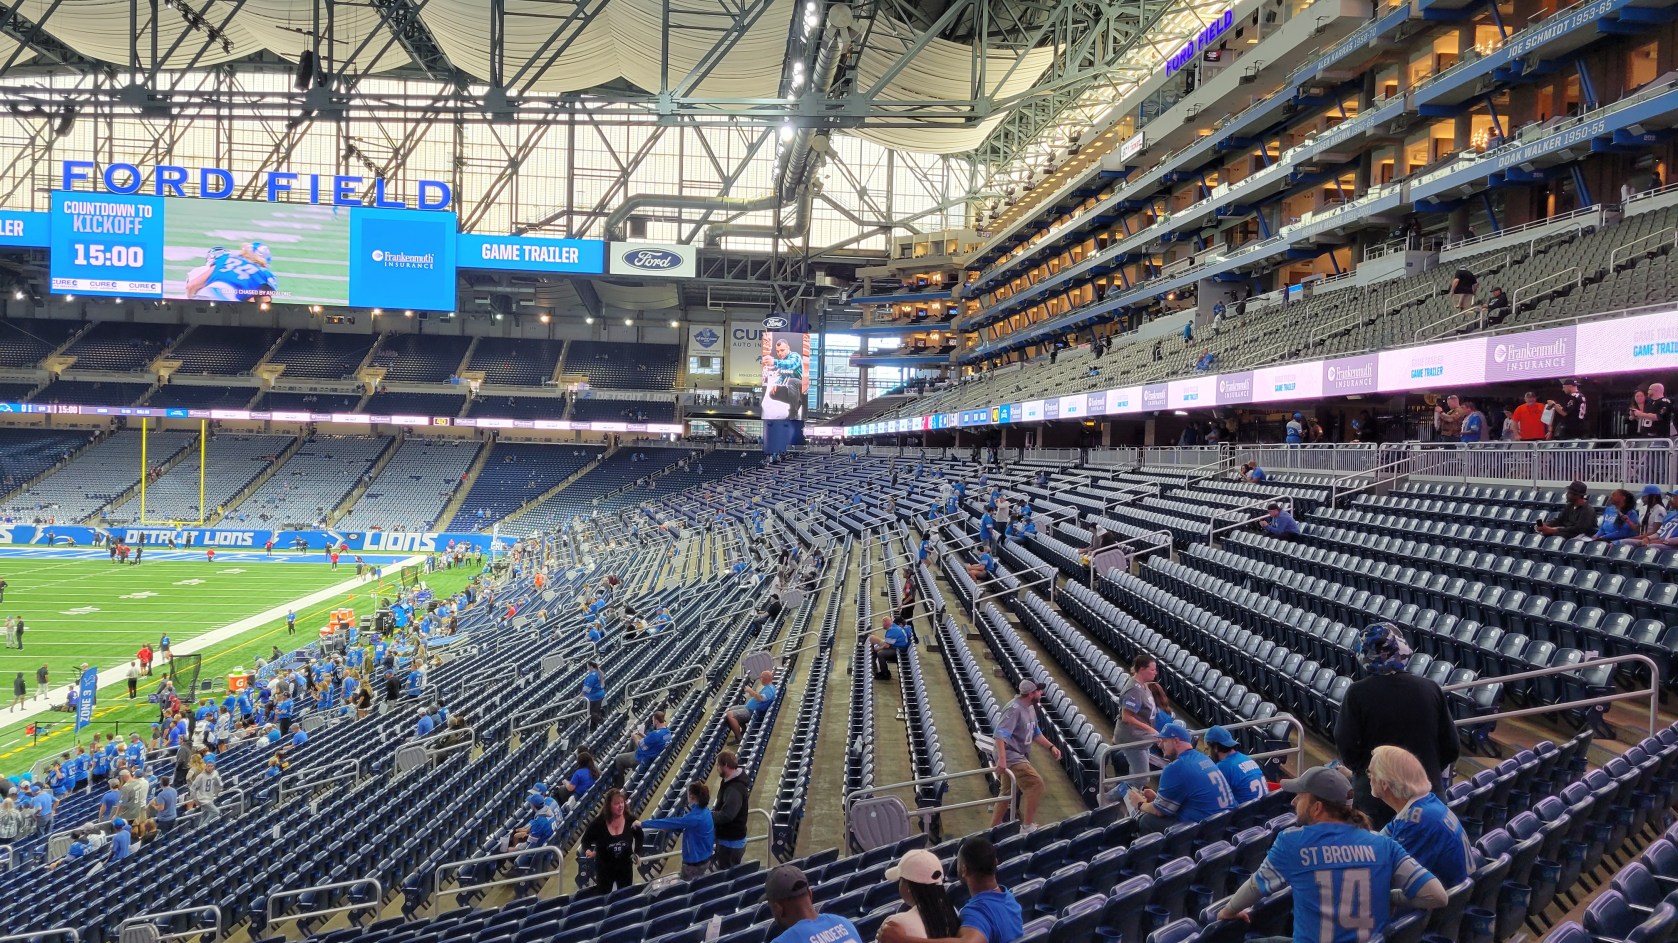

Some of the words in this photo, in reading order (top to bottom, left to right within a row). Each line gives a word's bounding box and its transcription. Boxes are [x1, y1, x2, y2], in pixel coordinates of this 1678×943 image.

[1507, 42, 1523, 59] JOE
[1525, 20, 1570, 50] SCHMIDT
[1571, 0, 1612, 28] 1953-65
[1166, 40, 1195, 77] FORD
[1197, 9, 1233, 51] FIELD
[1317, 59, 1330, 70] ALEX
[1331, 43, 1353, 61] KARRAS
[1498, 154, 1521, 168] DOAK
[1524, 136, 1561, 158] WALKER
[1563, 120, 1605, 146] 1950-55
[62, 160, 235, 200] FORD
[267, 171, 452, 211] FIELD
[64, 201, 135, 217] COUNTDOWN
[138, 204, 153, 218] TO
[73, 215, 143, 235] KICKOFF
[74, 243, 144, 268] 15:00
[384, 251, 434, 264] Frankenmuth
[481, 243, 520, 261] GAME
[523, 245, 579, 264] TRAILER
[634, 248, 672, 268] Ford
[384, 261, 434, 270] INSURANCE
[129, 282, 150, 290] CURE
[1508, 337, 1566, 361] Frankenmuth
[1633, 344, 1654, 357] GAME
[1336, 363, 1372, 380] Frankenmuth
[1411, 368, 1424, 378] GAME
[1424, 366, 1443, 377] TRAILER
[1506, 357, 1565, 372] INSURANCE
[1335, 378, 1372, 389] INSURANCE
[596, 391, 643, 401] DETROIT
[646, 393, 676, 402] LIONS
[1224, 390, 1249, 399] INSURANCE
[58, 405, 78, 413] 15:00
[203, 531, 255, 546] LIONS
[362, 532, 439, 552] LIONS
[235, 679, 244, 687] G
[83, 689, 92, 697] 3
[80, 698, 92, 722] ZONE
[1299, 847, 1318, 867] ST
[1322, 844, 1377, 865] BROWN
[1313, 867, 1376, 943] 14
[809, 923, 850, 943] SANDERS
